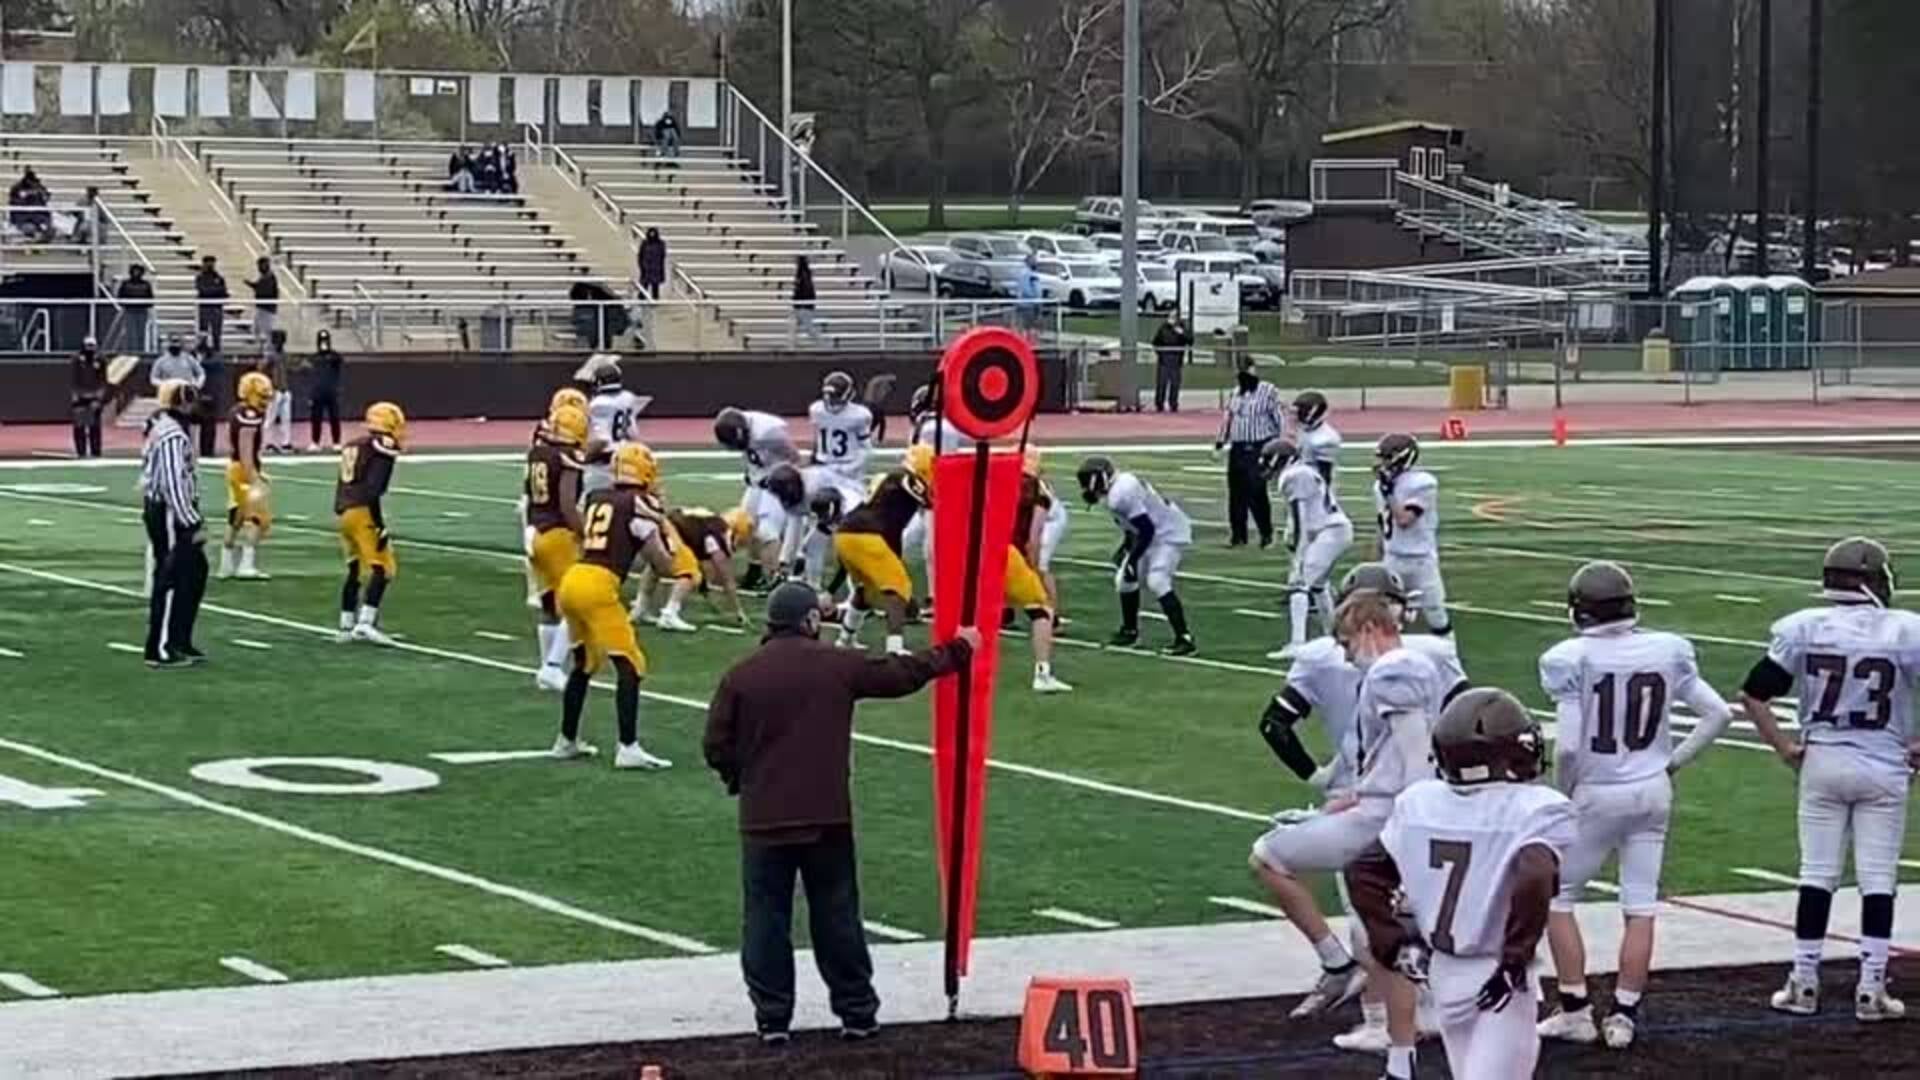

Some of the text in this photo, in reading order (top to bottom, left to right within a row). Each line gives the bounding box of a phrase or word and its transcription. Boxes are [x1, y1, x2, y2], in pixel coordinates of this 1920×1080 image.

[820, 429, 848, 457] 13
[585, 503, 614, 550] 12
[1591, 672, 1667, 754] 10
[1807, 654, 1896, 730] 73
[1430, 839, 1474, 955] 7
[1043, 988, 1130, 1070] 40
